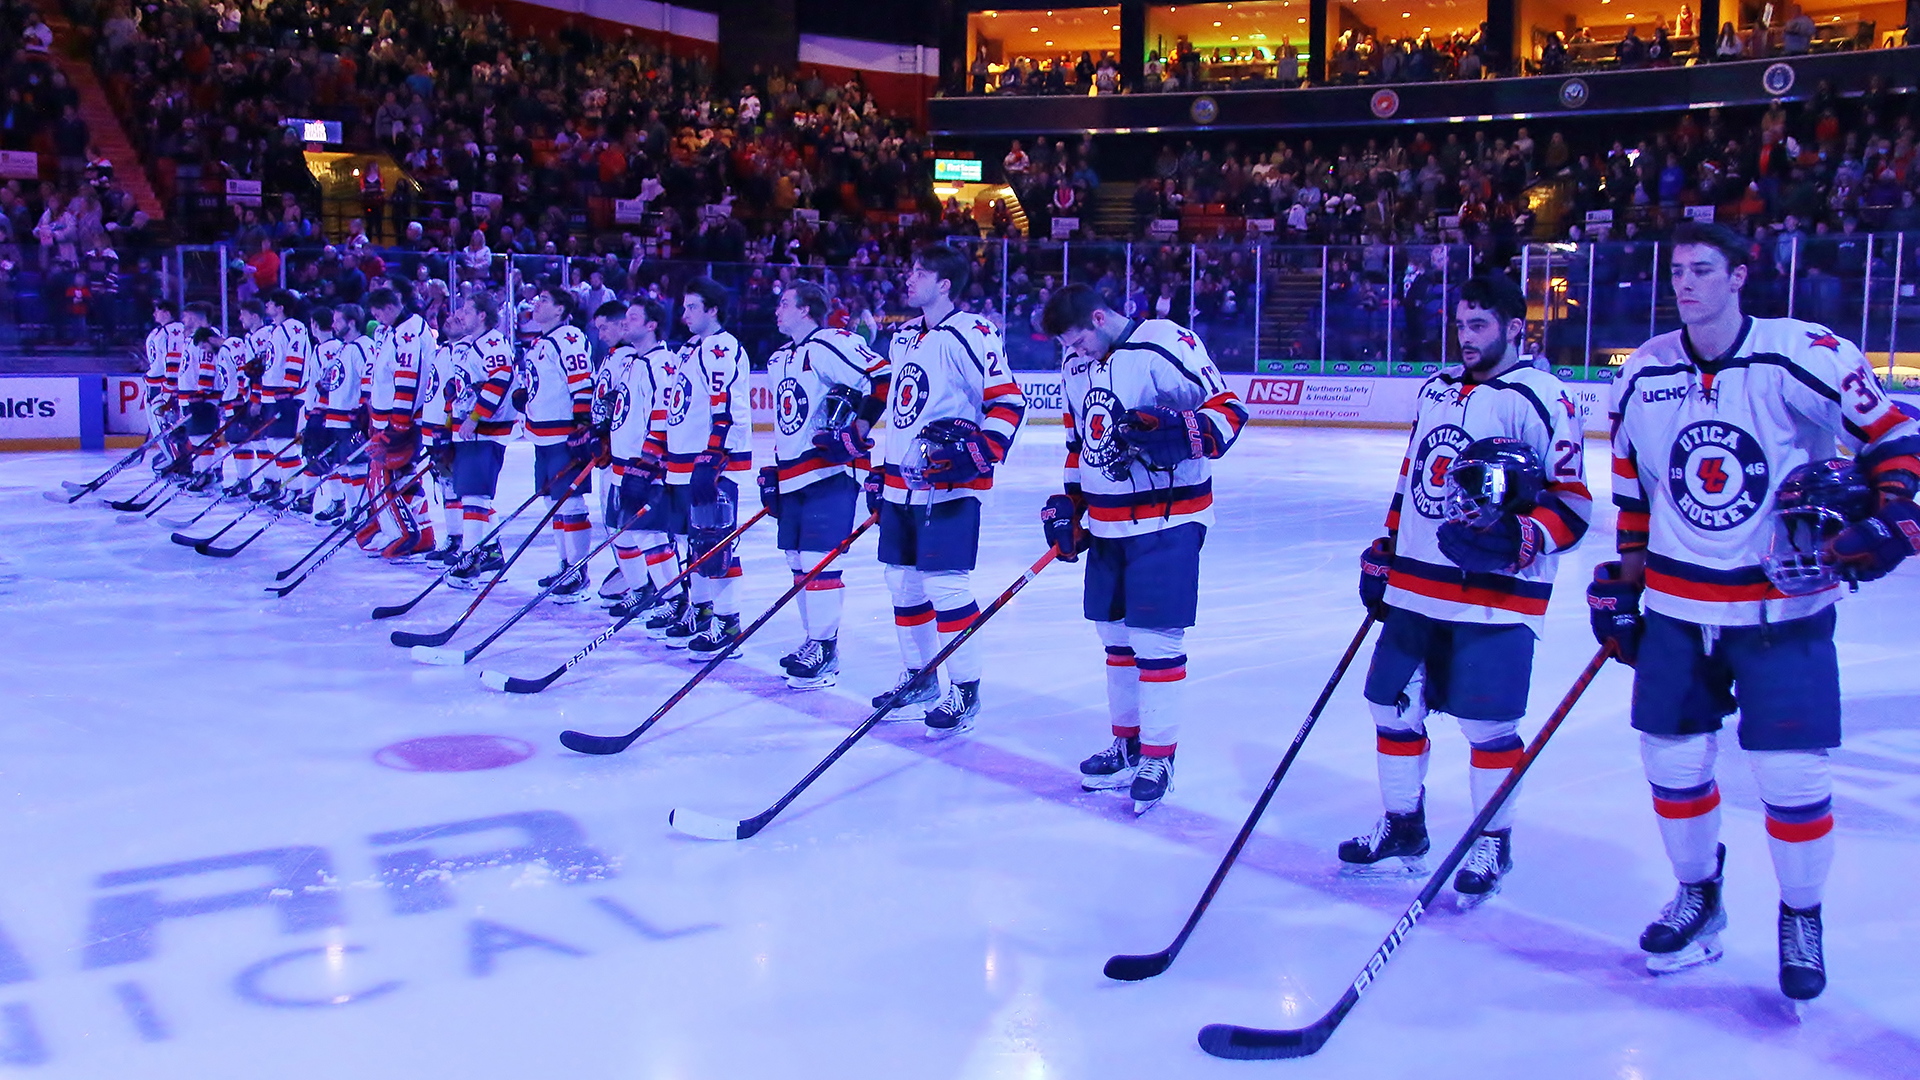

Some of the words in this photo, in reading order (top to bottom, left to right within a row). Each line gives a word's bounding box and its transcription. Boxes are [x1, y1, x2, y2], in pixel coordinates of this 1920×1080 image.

[291, 341, 299, 352] 4
[485, 354, 507, 368] 39
[566, 353, 588, 372] 36
[712, 371, 725, 392] 5
[1024, 383, 1062, 396] UTICA
[1306, 384, 1342, 393] Northern
[1344, 385, 1369, 394] Safety
[1251, 381, 1299, 401] NSI
[1314, 394, 1352, 402] Industrial
[1028, 397, 1062, 410] BOILE
[1085, 391, 1115, 410] UTICA
[1258, 408, 1360, 418] northernsafety.com
[1427, 428, 1470, 452] UTICA
[1679, 425, 1741, 452] UTICA
[1670, 467, 1683, 480] 19
[1744, 462, 1766, 476] 46
[1413, 482, 1443, 516] HOCK
[1678, 490, 1757, 527] HOCKEY
[1353, 898, 1426, 998] BAUER
